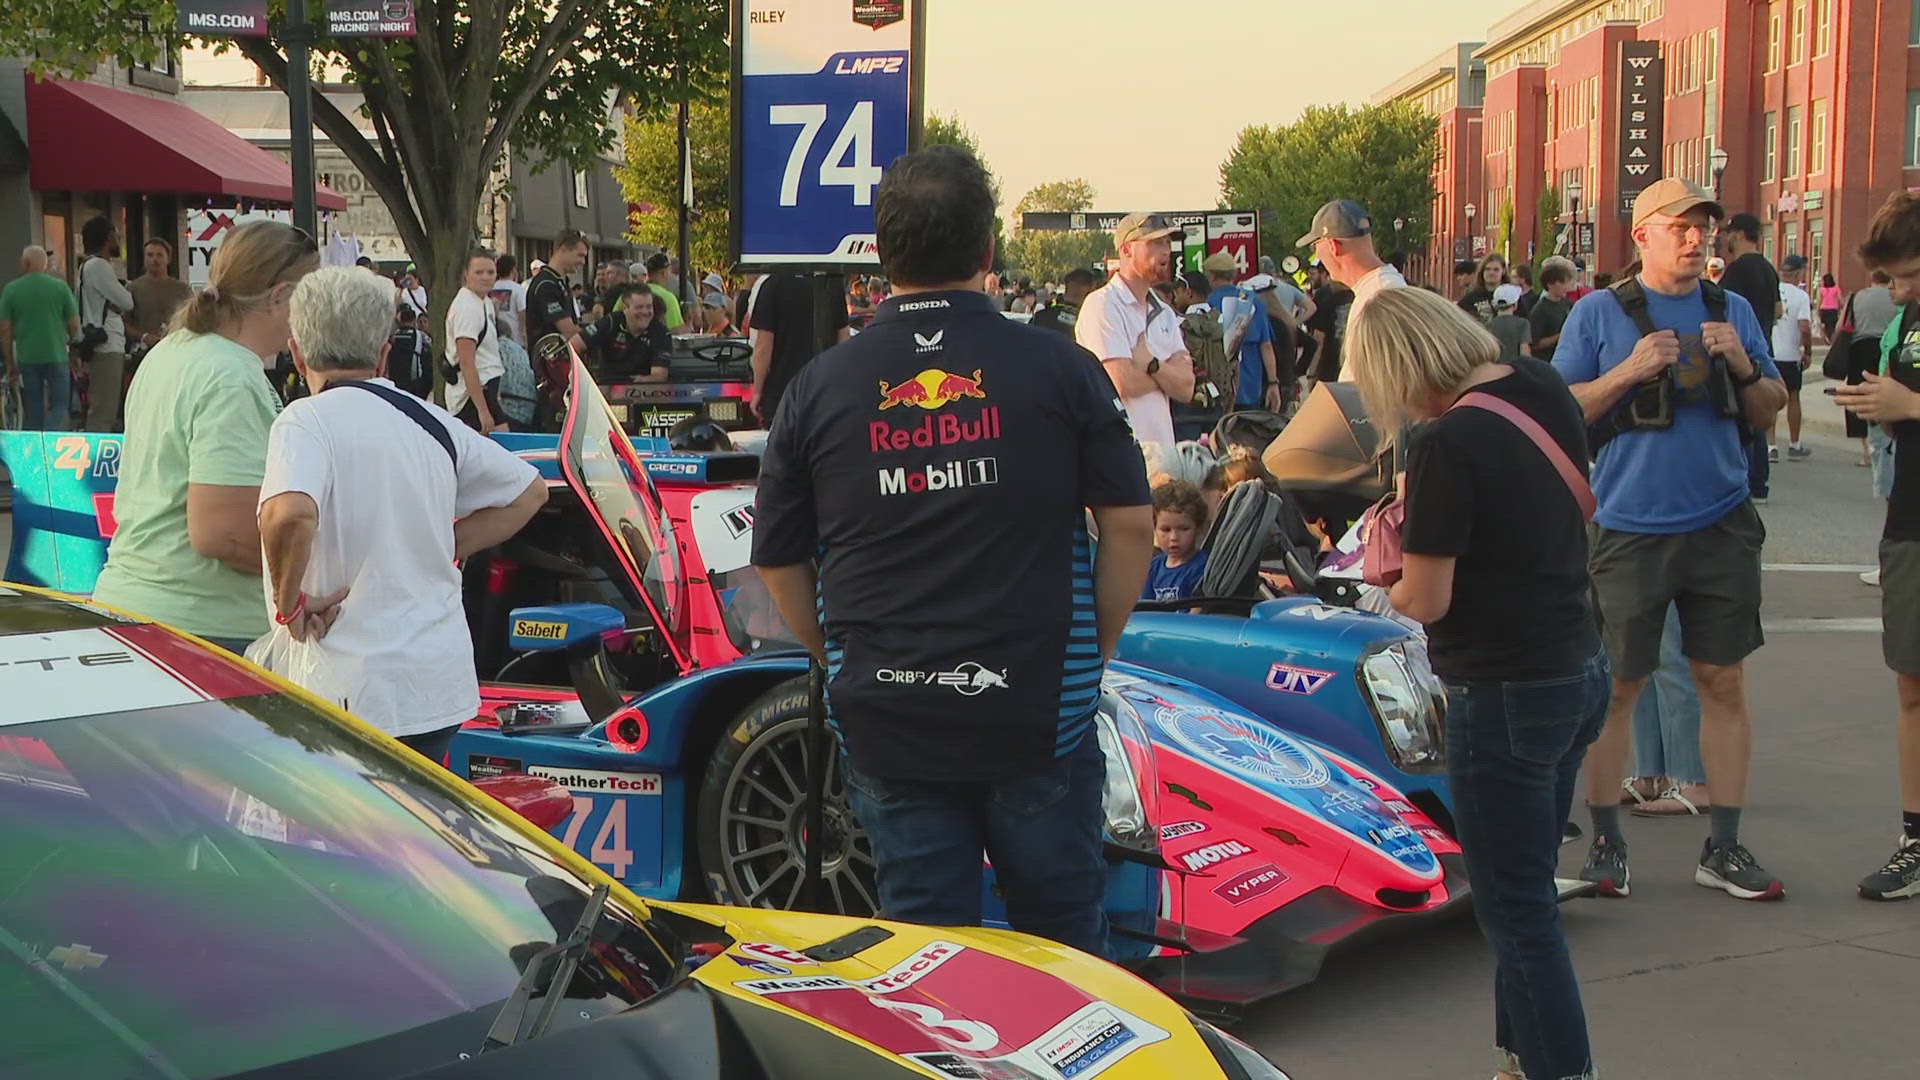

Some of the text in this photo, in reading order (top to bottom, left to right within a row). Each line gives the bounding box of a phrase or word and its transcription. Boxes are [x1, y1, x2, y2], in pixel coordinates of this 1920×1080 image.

[189, 13, 254, 28] IMS.COM
[330, 11, 379, 22] IMS.COM
[331, 23, 369, 32] RACING
[380, 22, 411, 31] NIGHT
[750, 11, 786, 24] RILEY
[835, 57, 904, 75] LMP2
[1625, 57, 1652, 175] WILSHAW
[769, 101, 883, 207] 74
[899, 300, 950, 312] HONDA
[869, 406, 1000, 452] Red Bull
[878, 461, 963, 496] Mobil
[516, 621, 561, 638] Sabelt
[563, 796, 633, 878] 74
[1182, 840, 1251, 872] MOTUL
[1228, 870, 1279, 897] VYPER
[868, 996, 999, 1051] 3
[1057, 1025, 1121, 1068] ENDURANCE CUP
